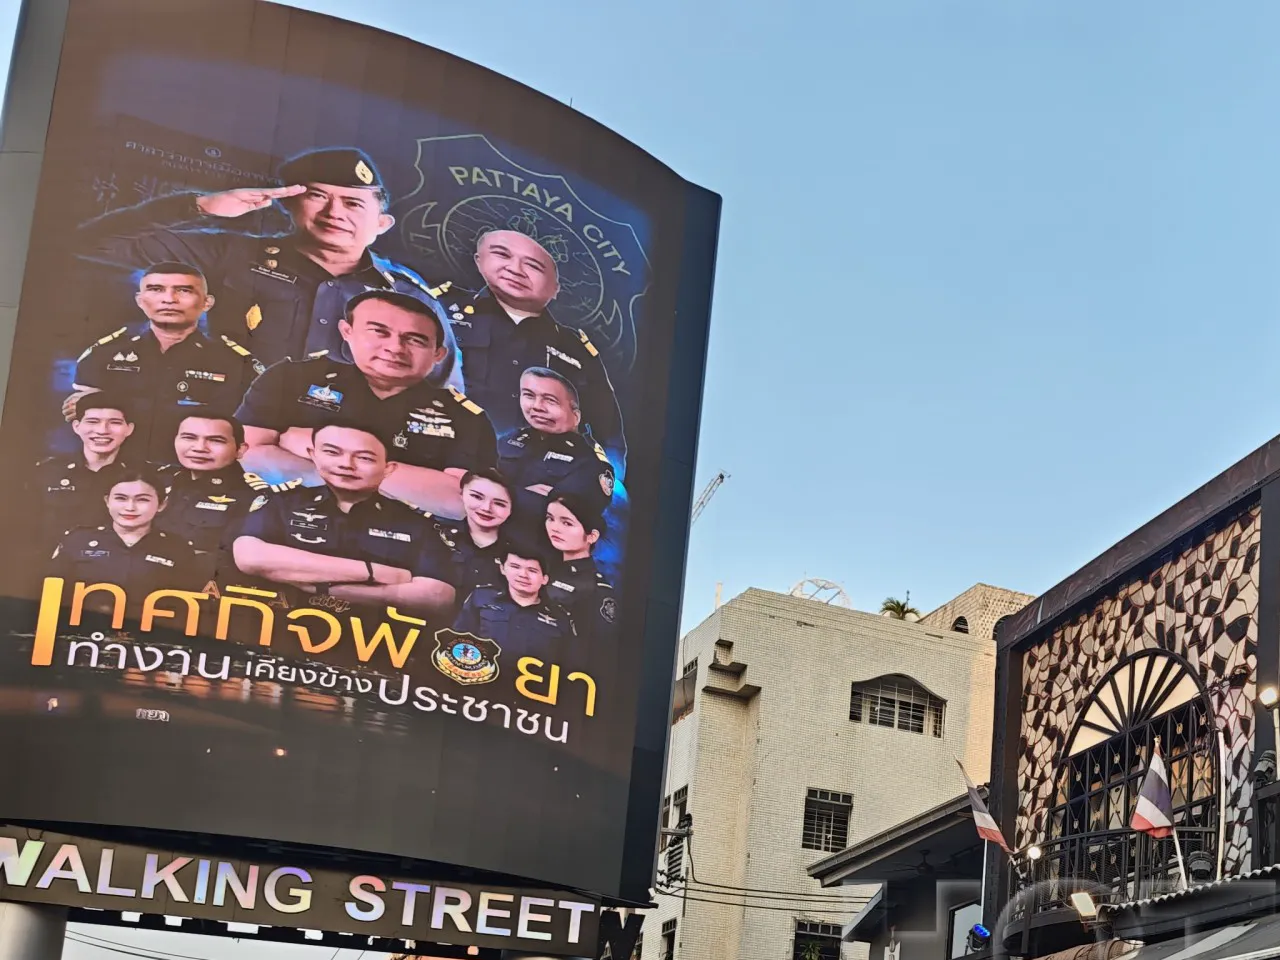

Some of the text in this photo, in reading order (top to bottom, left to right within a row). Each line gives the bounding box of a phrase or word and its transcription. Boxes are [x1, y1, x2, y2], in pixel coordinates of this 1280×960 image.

[449, 166, 631, 276] PATTAYA CITY
[0, 836, 314, 914] WALKING
[344, 875, 596, 944] STREET
